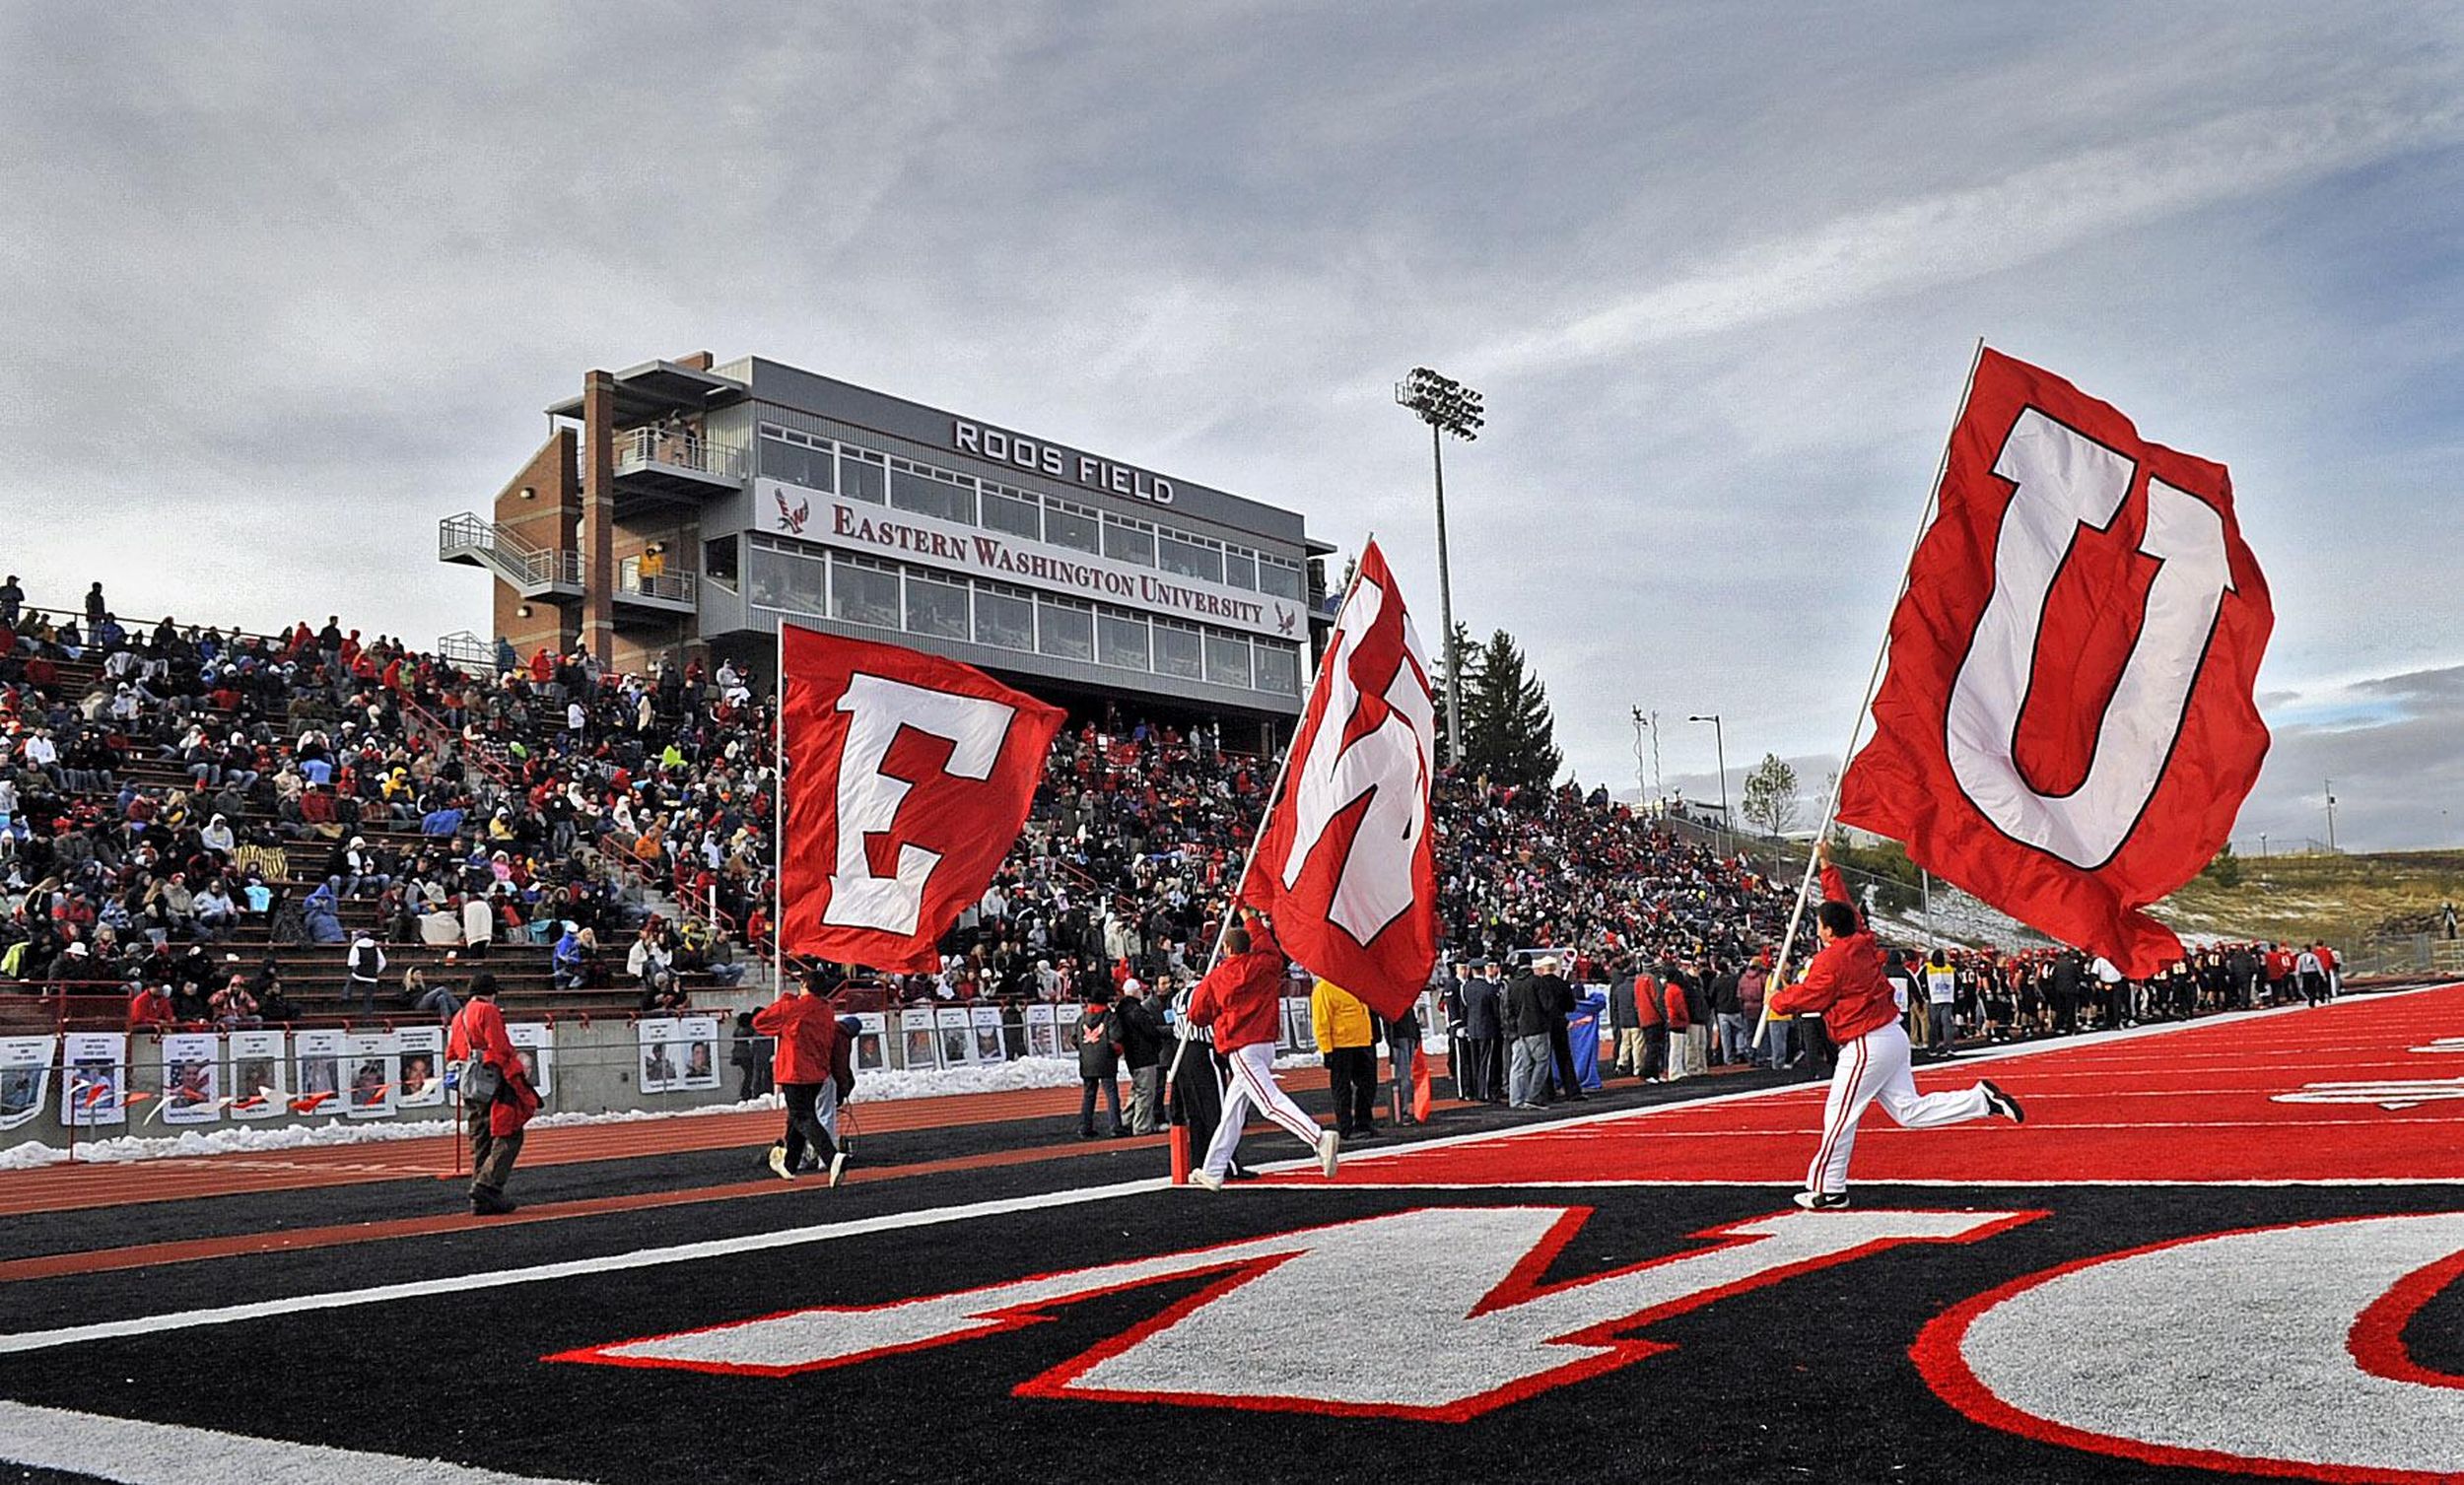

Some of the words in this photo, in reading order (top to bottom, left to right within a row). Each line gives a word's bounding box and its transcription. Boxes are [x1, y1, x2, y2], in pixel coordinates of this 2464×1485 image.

[954, 420, 1063, 476] ROOS
[1078, 455, 1174, 505] FIELD
[832, 504, 968, 563] EASTERN
[971, 535, 1134, 598] WASHINGTON
[1139, 574, 1264, 625] UNIVERSITY
[1946, 402, 2238, 871] U
[822, 670, 1019, 936] E
